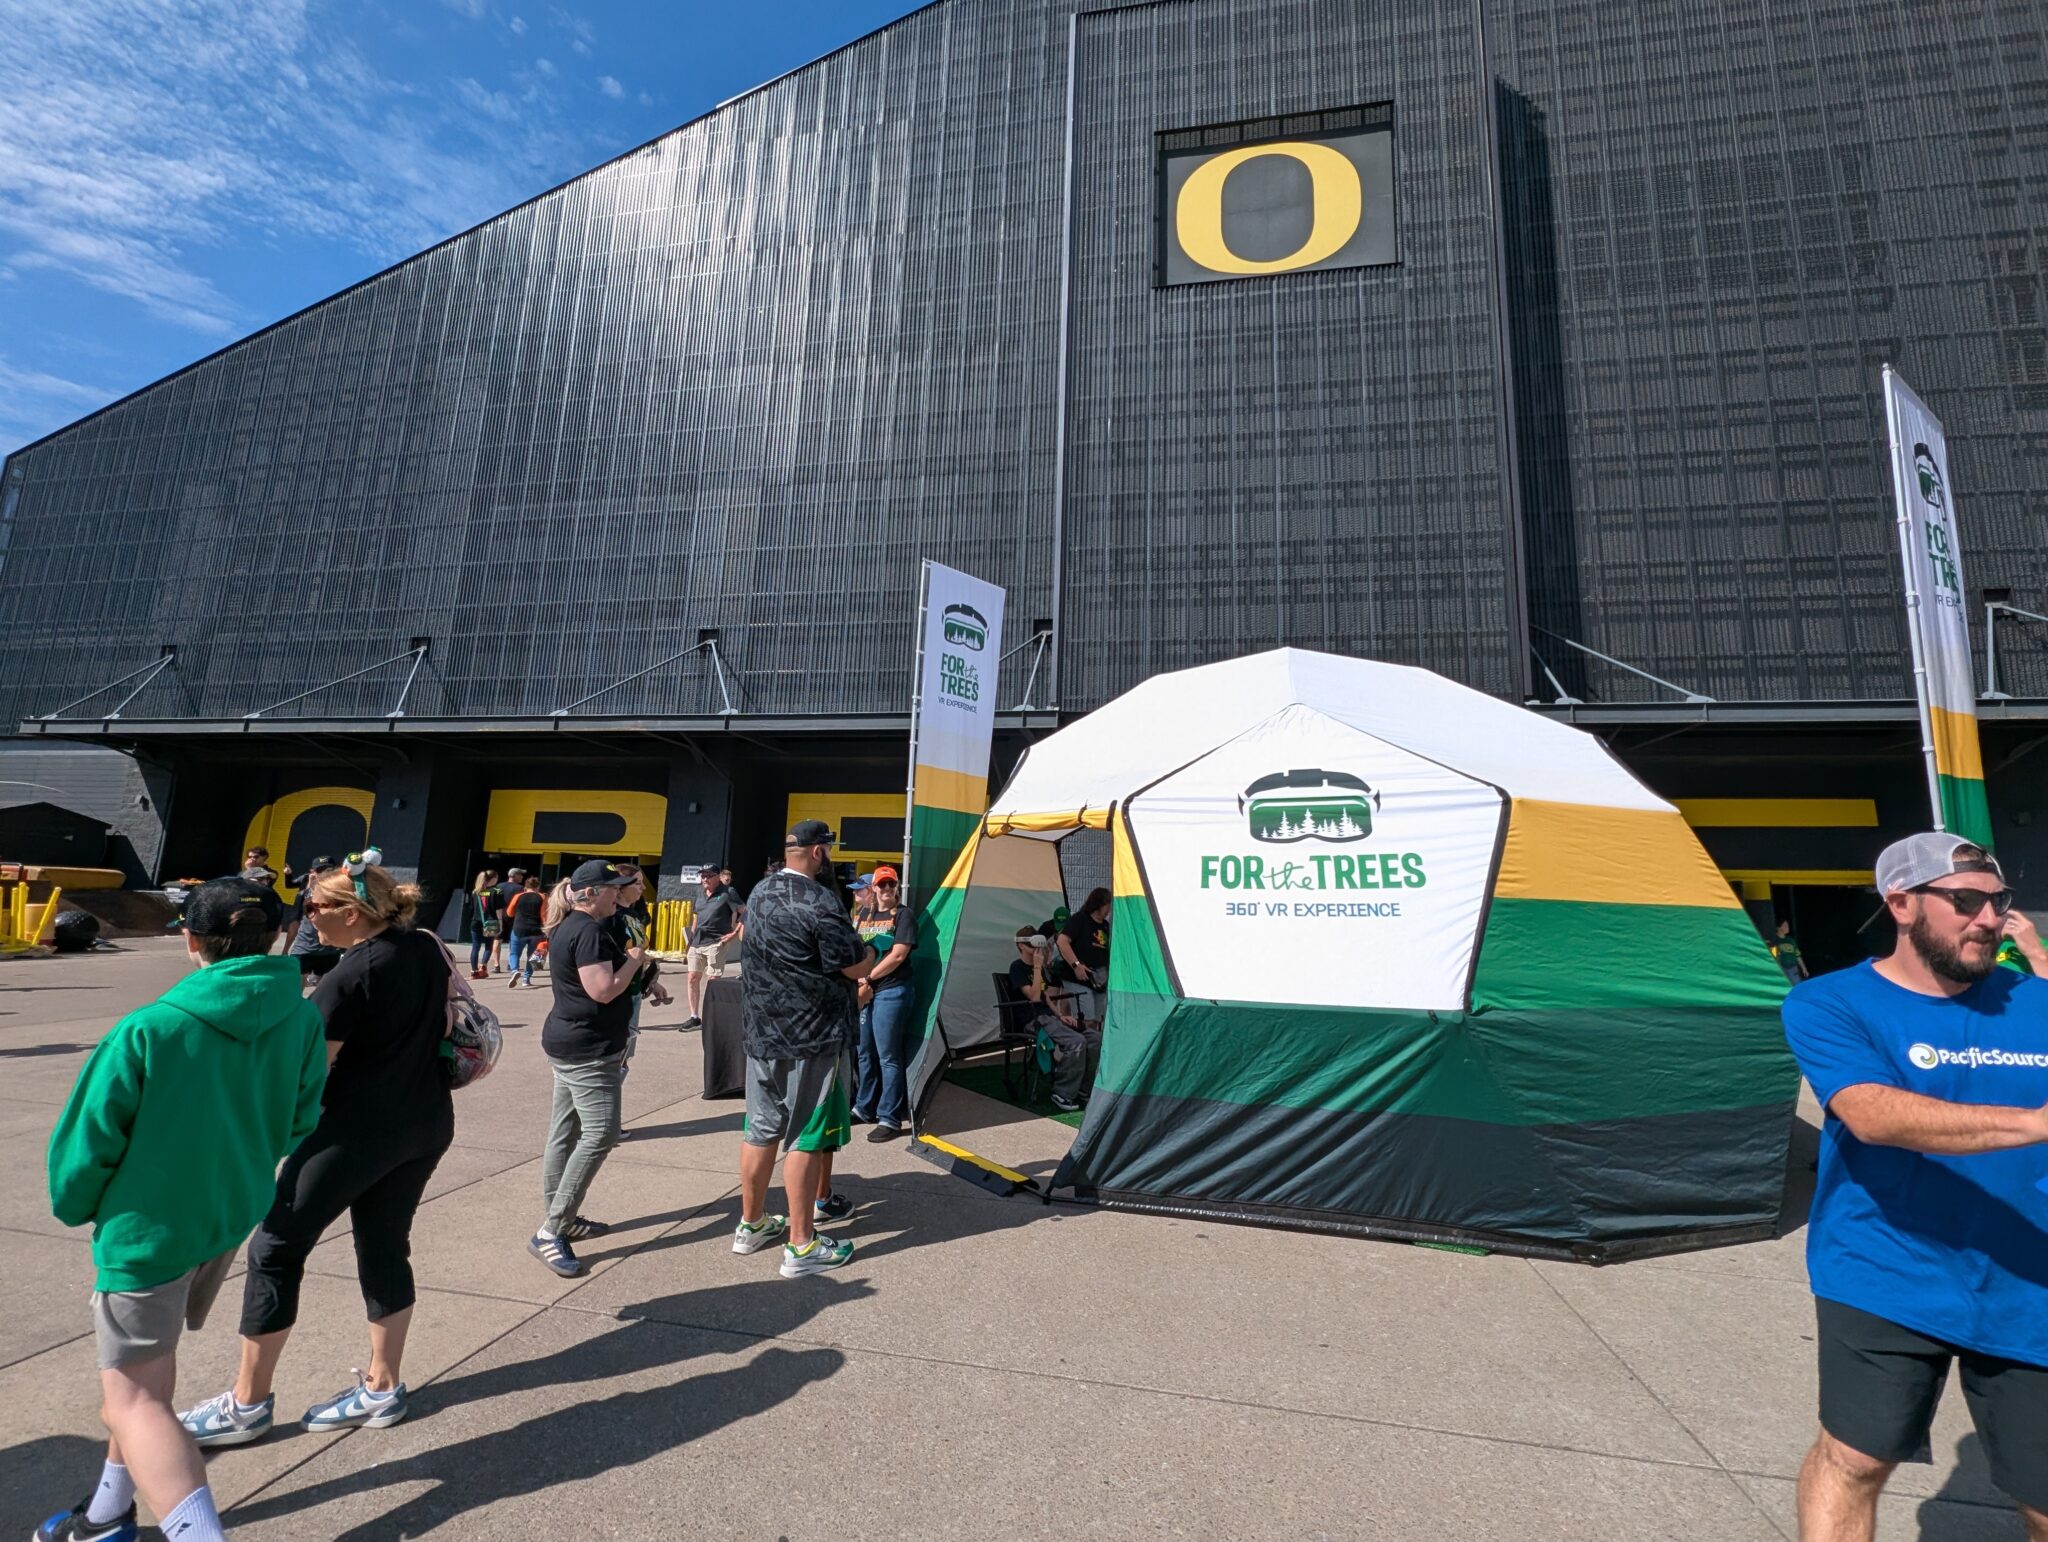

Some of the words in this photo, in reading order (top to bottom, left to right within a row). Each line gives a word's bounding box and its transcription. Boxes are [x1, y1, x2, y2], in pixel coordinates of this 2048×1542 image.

[1175, 142, 1362, 275] O
[941, 652, 965, 676] FOR
[964, 665, 979, 681] the
[938, 696, 946, 705] VR
[940, 672, 979, 702] TREES
[1200, 854, 1265, 889] FOR
[1262, 861, 1315, 890] the
[1309, 852, 1427, 890] TREES
[1265, 902, 1289, 917] VR
[1294, 902, 1402, 917] EXPERIENCE
